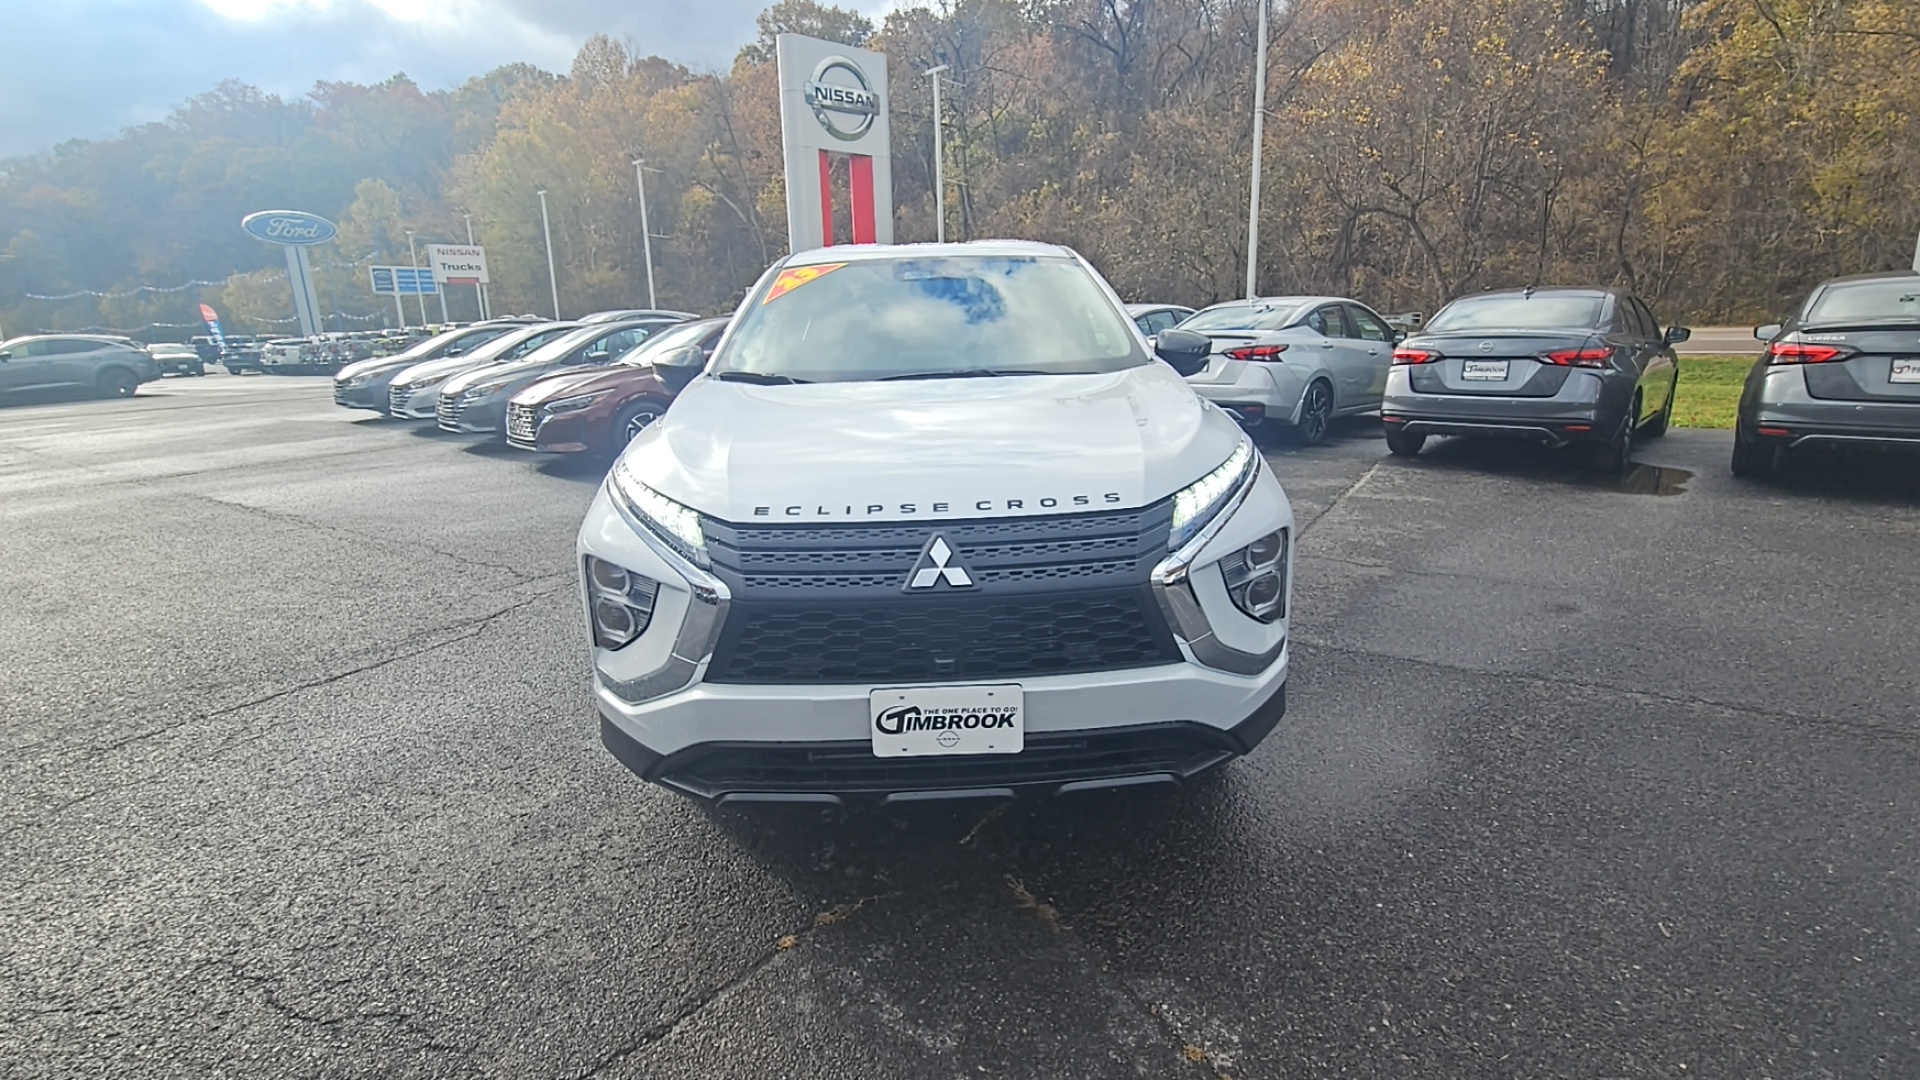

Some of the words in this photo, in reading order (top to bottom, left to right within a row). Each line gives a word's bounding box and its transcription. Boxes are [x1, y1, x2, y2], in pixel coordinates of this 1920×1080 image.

[814, 86, 875, 108] NISSAN
[266, 217, 319, 238] Ford
[437, 248, 480, 256] NISSAN
[440, 263, 482, 271] Trucks
[754, 502, 950, 517] ECLIPSE
[975, 492, 1121, 511] CROSS
[876, 705, 1016, 735] TIMBROOK
